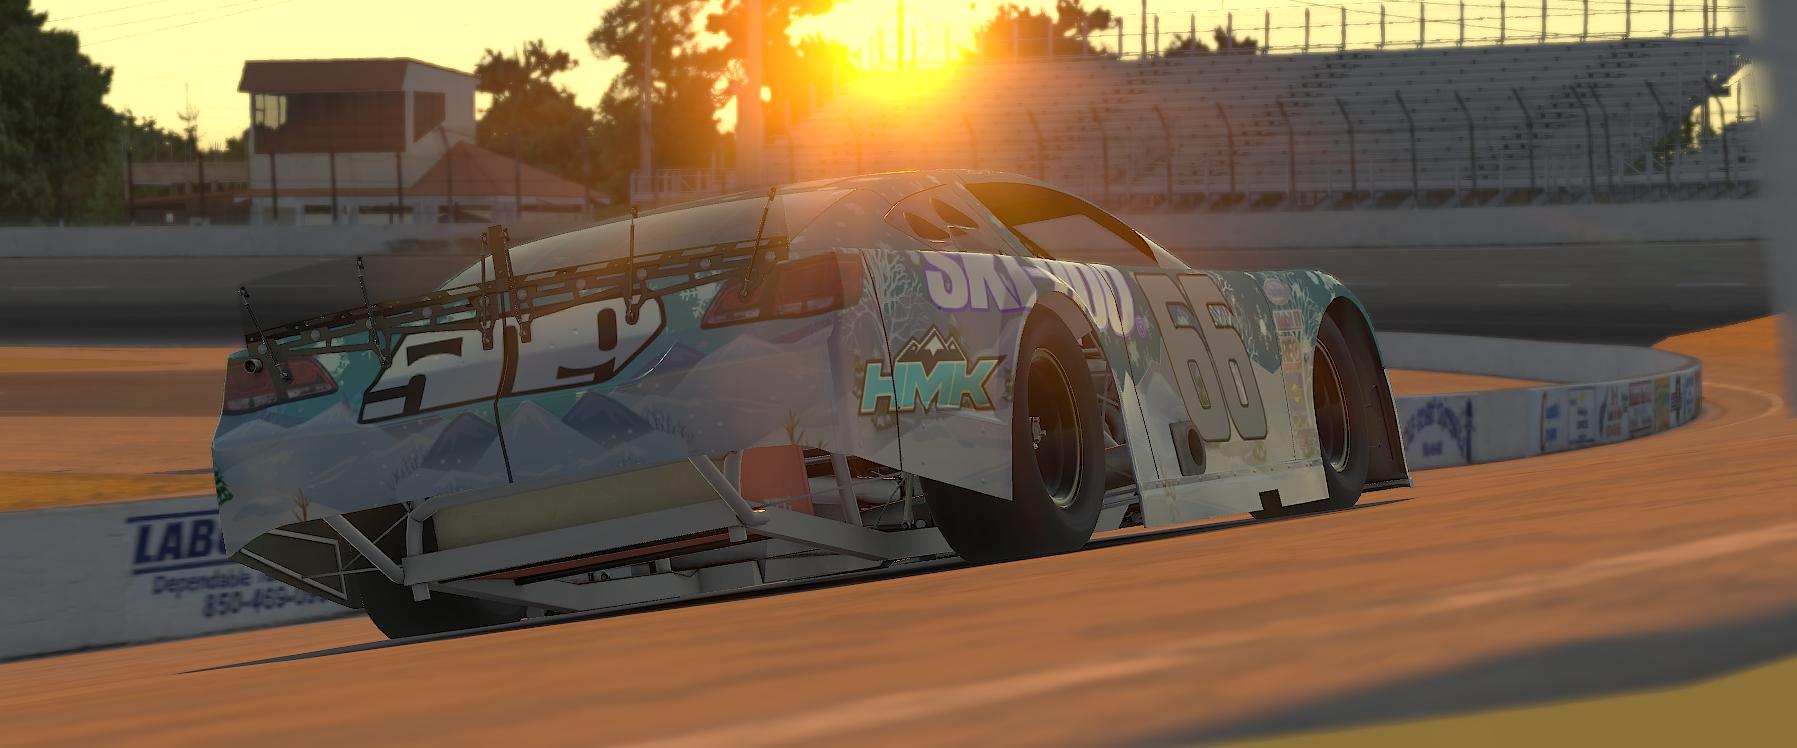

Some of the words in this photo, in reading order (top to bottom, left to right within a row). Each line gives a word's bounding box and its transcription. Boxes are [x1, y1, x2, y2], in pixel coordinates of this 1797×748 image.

[858, 353, 1007, 416] HMK
[1133, 271, 1269, 443] 66
[133, 518, 228, 564] LAB
